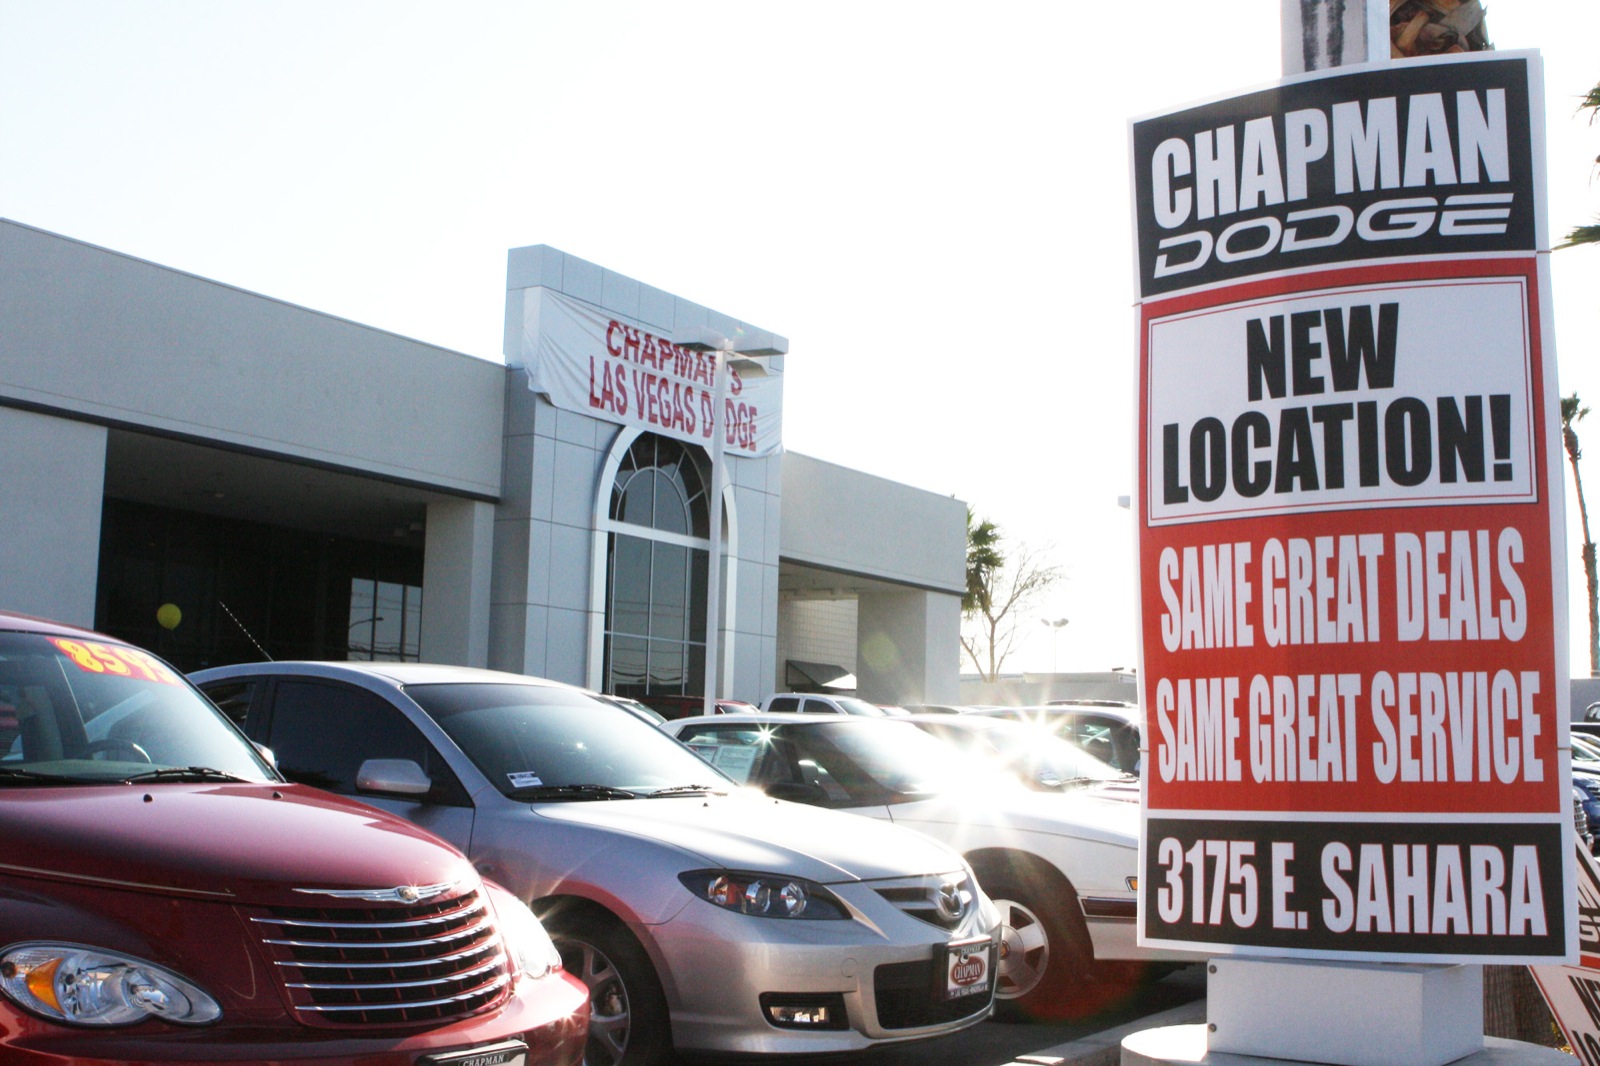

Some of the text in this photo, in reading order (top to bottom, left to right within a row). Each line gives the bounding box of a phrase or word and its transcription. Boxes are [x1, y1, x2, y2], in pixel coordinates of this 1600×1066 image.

[1151, 88, 1510, 229] CHAPMAN
[1153, 193, 1514, 278] DODGE
[1246, 303, 1399, 402] NEW
[589, 355, 758, 451] LAS VEGAS DDGE
[1162, 394, 1513, 505] LOCATION!
[1158, 526, 1527, 652] SAME GREAT DEALS
[1156, 669, 1544, 784] SAME GREAT SERVICE
[1157, 837, 1259, 929] 3175
[1271, 841, 1308, 930] E.
[1320, 841, 1548, 936] SAHARA
[954, 962, 981, 979] CHAPMAN
[462, 1054, 505, 1066] CHAPMAN
